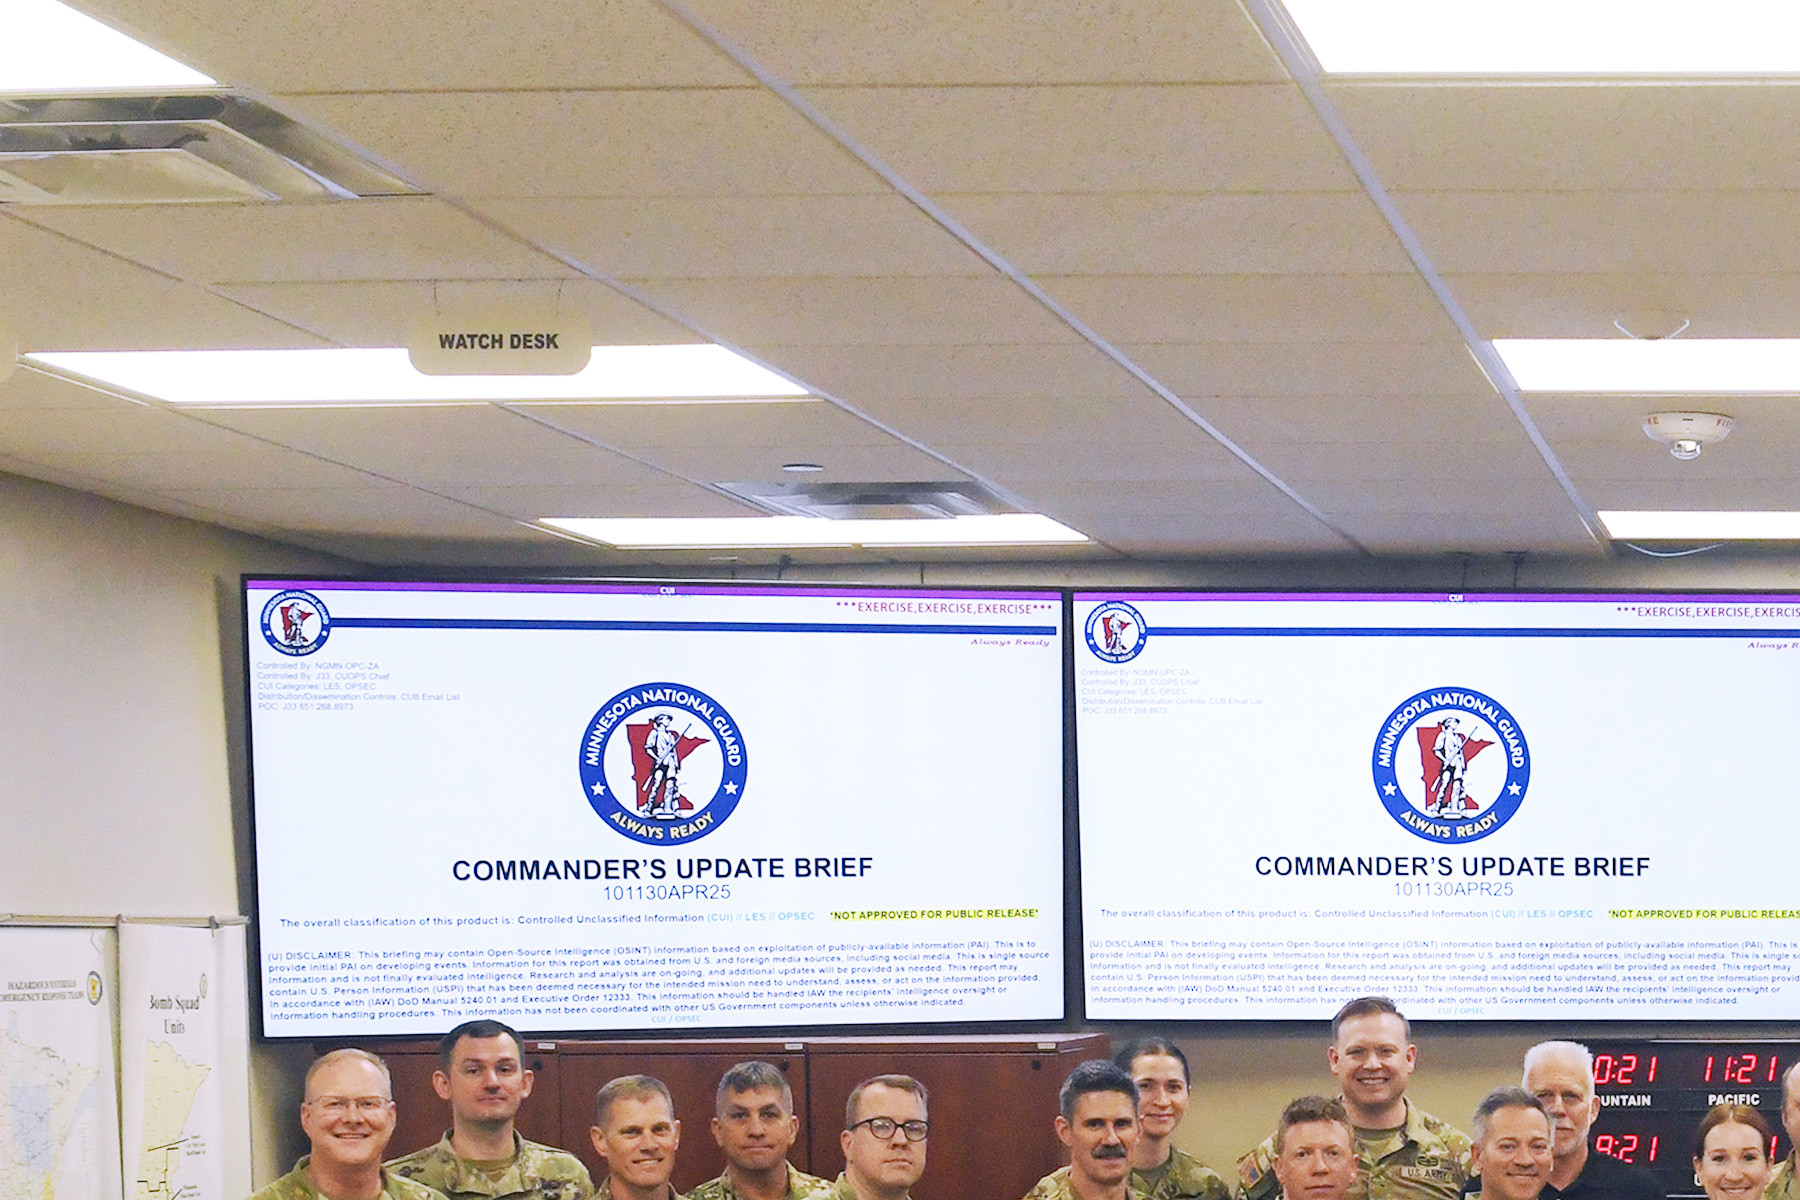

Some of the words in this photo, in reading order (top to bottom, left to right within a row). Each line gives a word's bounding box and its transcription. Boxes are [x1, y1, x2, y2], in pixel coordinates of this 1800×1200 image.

[438, 334, 503, 350] WATCH
[510, 334, 559, 350] DESK
[970, 638, 1011, 647] Always
[1016, 639, 1050, 648] Ready
[1748, 642, 1788, 650] Always
[586, 694, 642, 766] MINNESOTA
[642, 689, 716, 720] NATIONAL
[712, 716, 741, 766] GUARD
[1378, 698, 1431, 768] MINNESOTA
[1430, 692, 1501, 723] NATIONAL
[1498, 719, 1524, 768] GUARD
[610, 812, 664, 840] ALWAYS
[670, 812, 714, 839] READY
[1400, 810, 1450, 838] ALWAYS
[1456, 811, 1498, 838] READY
[676, 858, 784, 879] UPDATE
[794, 857, 872, 877] BRIEF
[1463, 856, 1564, 876] UPDATE
[1574, 857, 1650, 876] BRIEF
[604, 884, 731, 900] 101130APR25
[1394, 881, 1514, 896] 101130APR25
[279, 918, 299, 927] The
[303, 918, 340, 927] overall
[343, 917, 416, 926] classification
[419, 917, 430, 926] of
[433, 917, 453, 925] this
[456, 917, 498, 926] product
[517, 915, 573, 924] Controlled
[576, 914, 641, 924] Unclassified
[644, 913, 704, 922] Information
[706, 912, 733, 922] (CUI)
[745, 912, 766, 921] LES
[778, 912, 814, 920] OPSEC
[859, 911, 917, 919] APPROVED
[921, 910, 942, 919] FOR
[946, 910, 984, 918] PUBLIC
[1636, 910, 1693, 918] APPROVED
[1696, 910, 1718, 918] FOR
[1720, 910, 1758, 918] PUBLIC
[285, 950, 355, 960] DISCLAIMER:
[382, 950, 420, 960] briefing
[447, 949, 484, 957] contain
[487, 948, 551, 958] Open-Source
[554, 948, 610, 957] Intelligence
[613, 946, 651, 955] (OSINT)
[654, 946, 709, 954] information
[712, 945, 740, 953] based
[758, 944, 813, 953] exploitation
[828, 942, 909, 952] publicly-available
[912, 942, 964, 950] information
[967, 941, 991, 949] (PAI).
[995, 940, 1013, 948] This
[149, 994, 172, 1010] Bomb
[175, 995, 200, 1013] Squad
[1592, 1054, 1658, 1084] 0:21
[1704, 1054, 1778, 1084] 11:21
[1600, 1094, 1652, 1106] UNTAIN
[1708, 1094, 1760, 1106] PACIFIC
